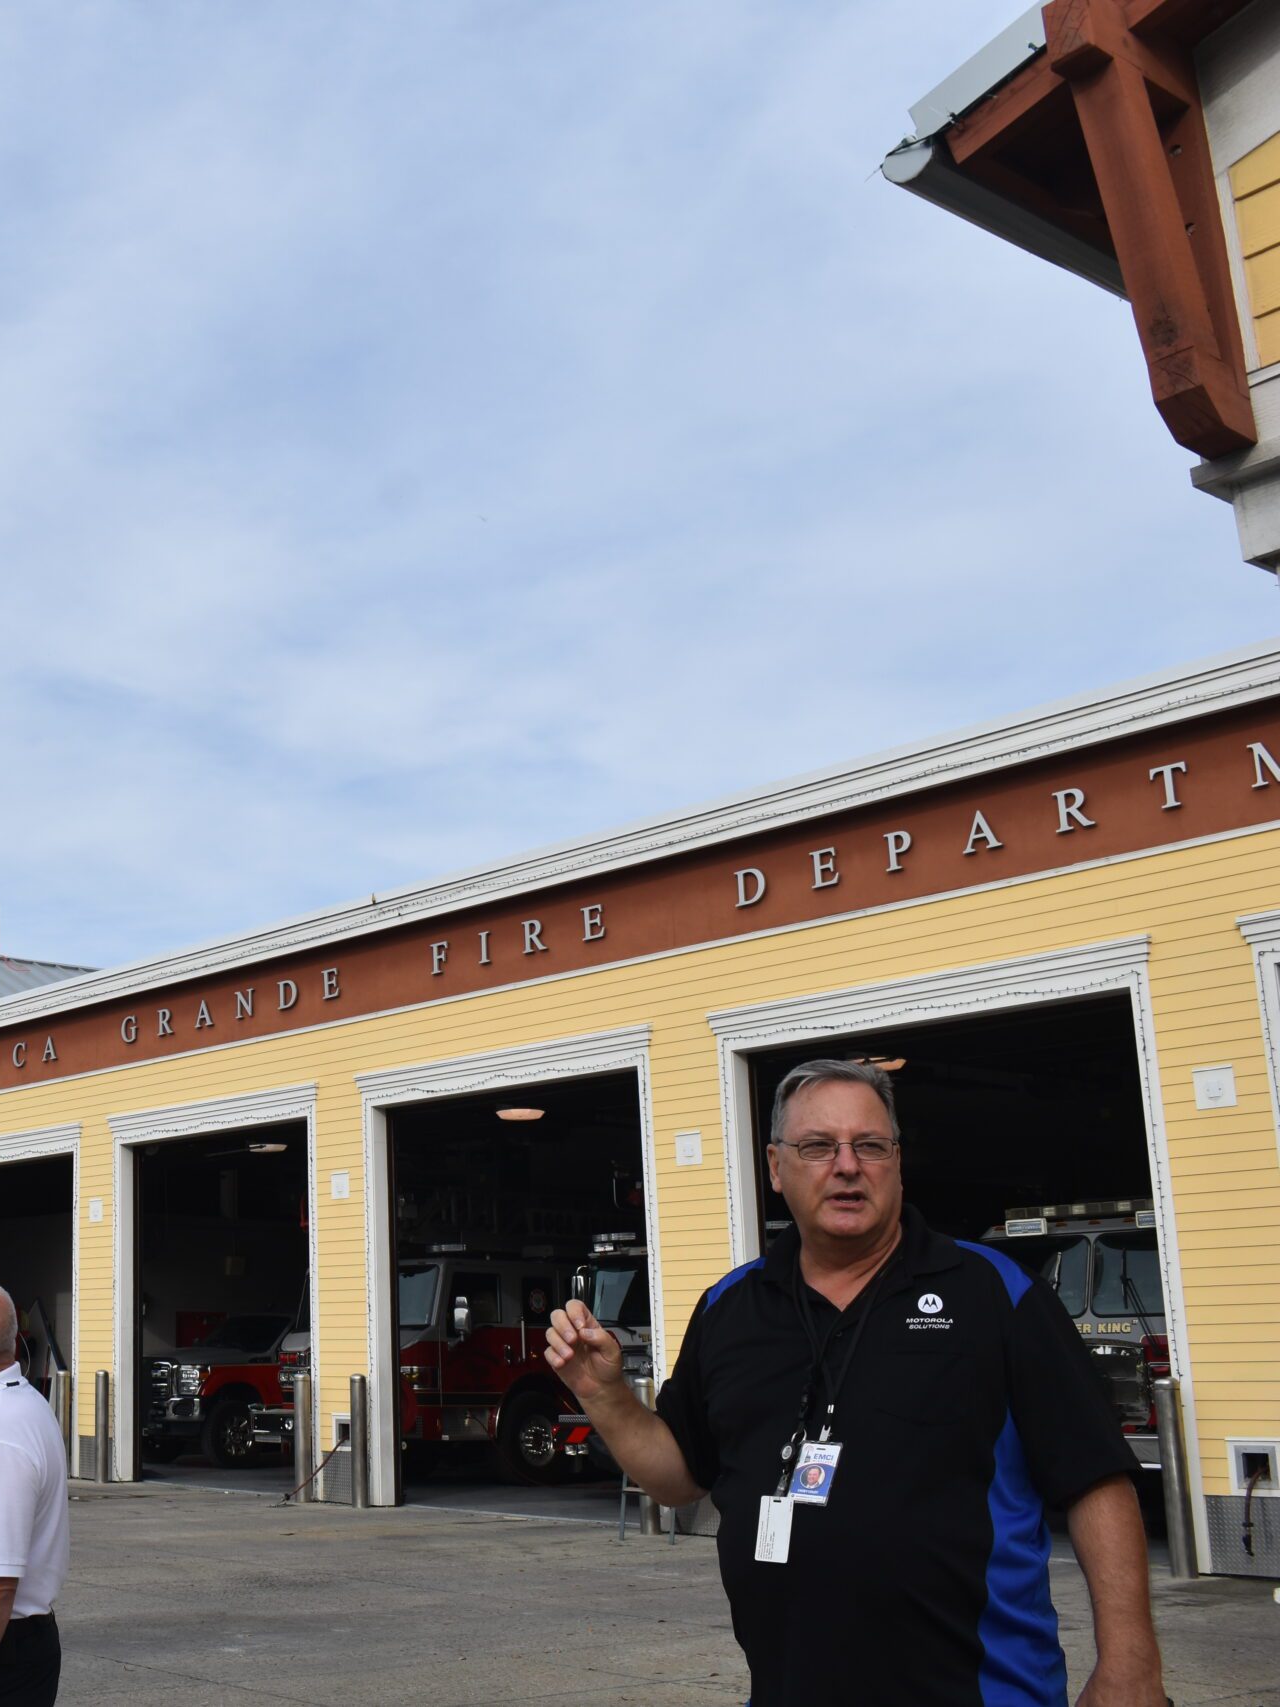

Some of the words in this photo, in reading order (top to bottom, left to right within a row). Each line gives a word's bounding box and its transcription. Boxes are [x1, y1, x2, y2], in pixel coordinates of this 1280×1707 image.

[120, 967, 341, 1044] GRANDE
[429, 904, 606, 975] FIRE
[813, 1453, 835, 1461] EMCI
